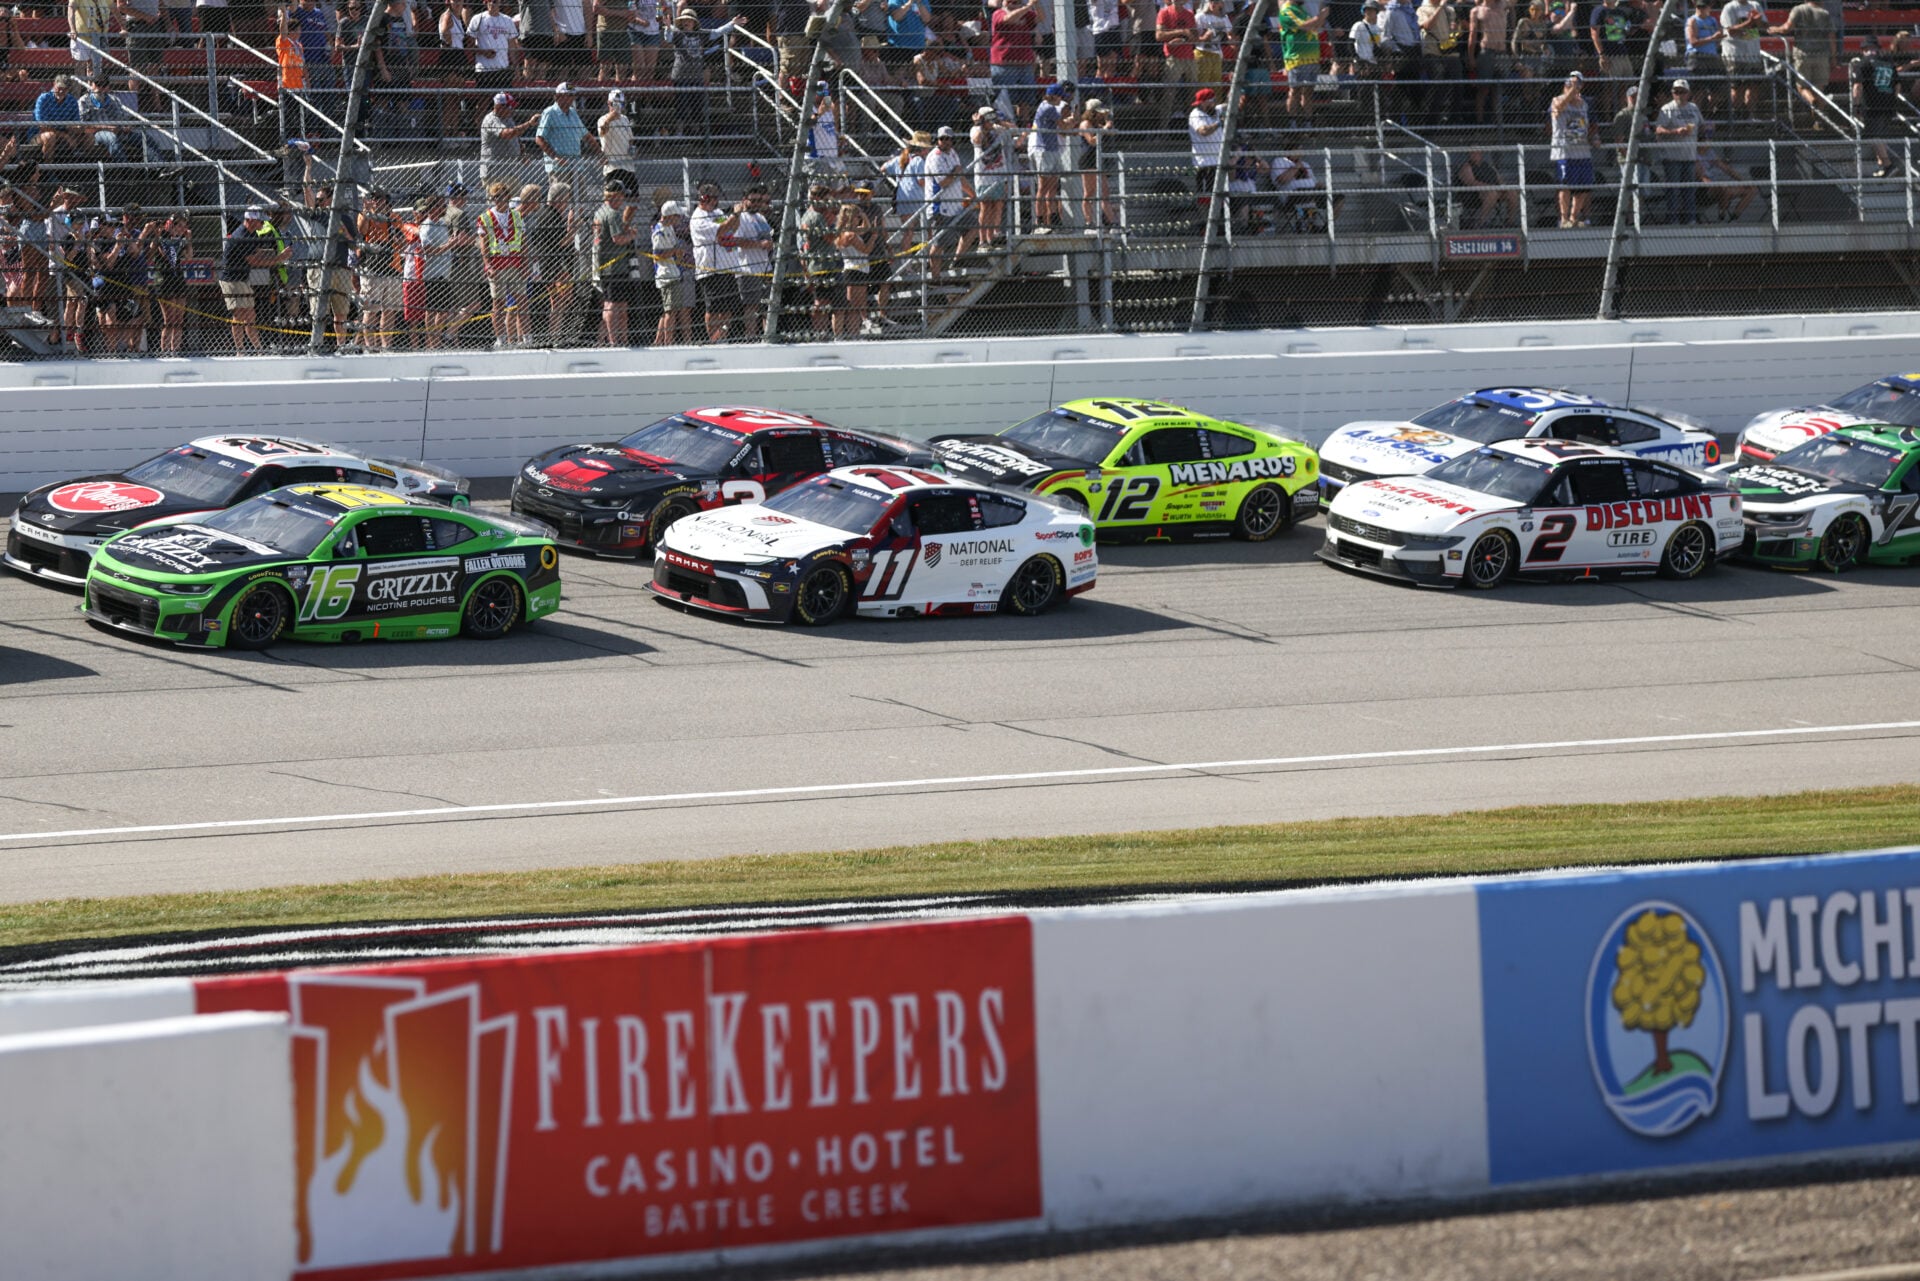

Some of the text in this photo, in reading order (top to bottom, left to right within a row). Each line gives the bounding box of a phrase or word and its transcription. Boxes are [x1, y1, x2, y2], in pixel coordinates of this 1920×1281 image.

[1449, 240, 1513, 254] SECTION 14
[711, 428, 739, 441] DILLON
[1086, 418, 1115, 430] BLANEY
[217, 459, 237, 470] BELL
[1169, 456, 1297, 487] MENARDS
[662, 485, 699, 496] GOODYEAR
[852, 488, 883, 501] HAMLIN
[1096, 475, 1161, 522] 12
[1585, 494, 1713, 531] DISCOUNT
[1878, 494, 1919, 545] 7
[949, 539, 1016, 556] NATIONAL
[1526, 514, 1577, 564] 2
[1612, 532, 1652, 545] TIRE
[117, 535, 222, 568] GRIZZLY
[668, 553, 710, 572] CAMRY
[960, 557, 1003, 567] DEBT RELIEF
[146, 552, 195, 574] POUCHES
[465, 558, 492, 574] FALLEN
[492, 555, 527, 571] OUTDOORS
[862, 548, 917, 600] 11
[247, 570, 284, 581] GOODYEAR
[367, 571, 459, 601] GRIZZLY
[299, 564, 362, 621] 16
[367, 596, 456, 612] NICOTINE POUCHES
[534, 988, 1009, 1132] FIREKEEPERS
[1743, 998, 1920, 1121] LOTT
[584, 1126, 966, 1197] CASINO HOTEL
[643, 1184, 912, 1238] BATTLE CREEK
